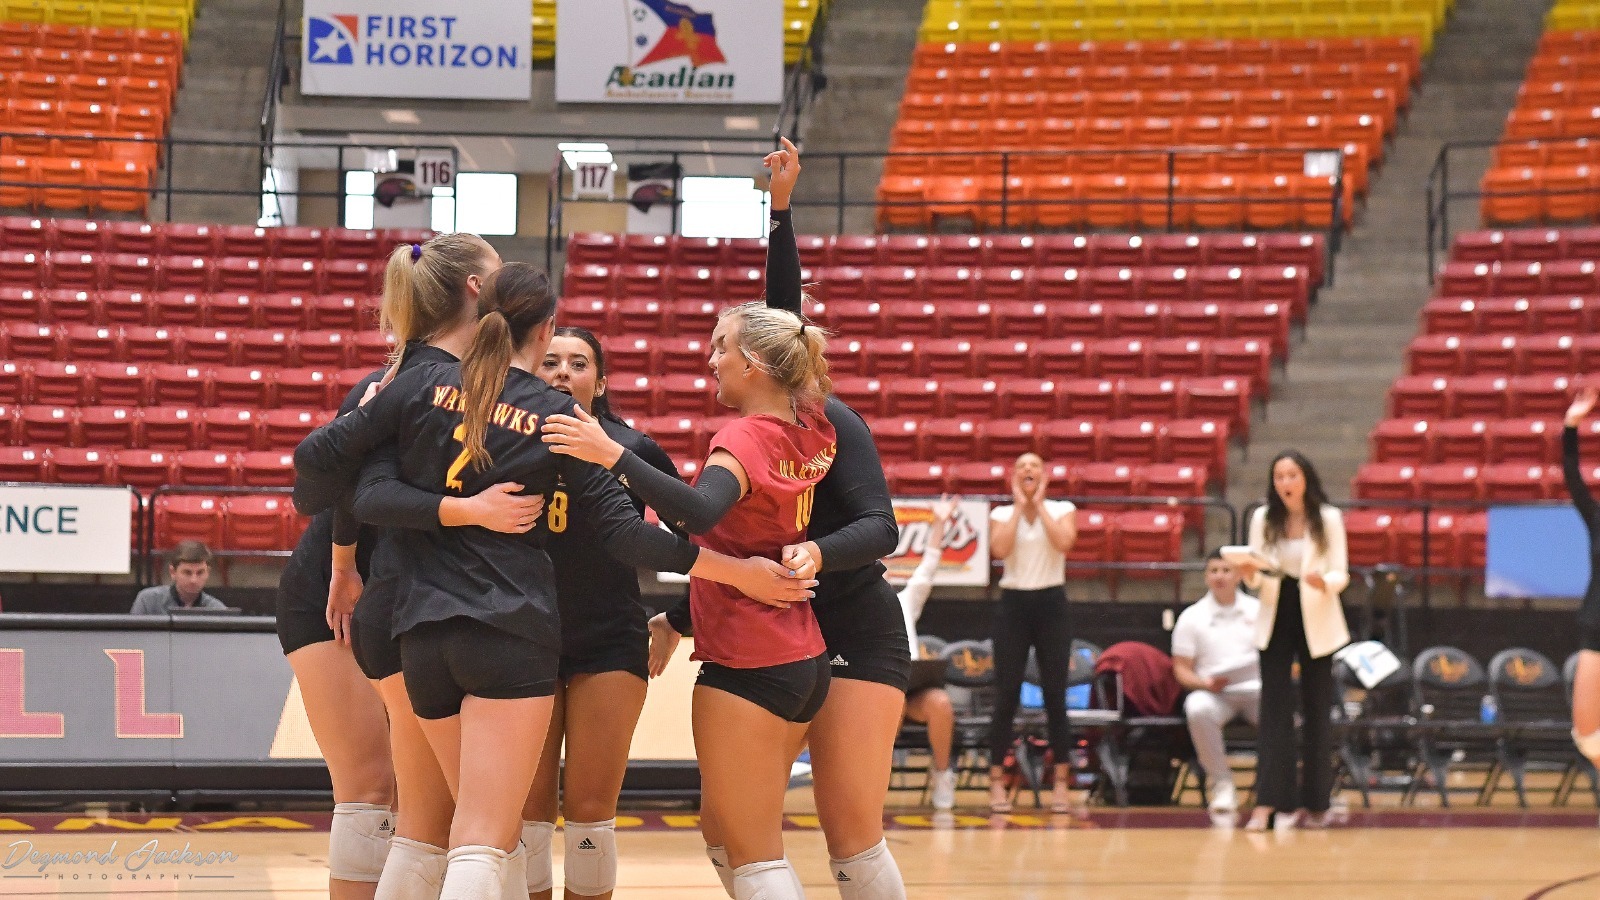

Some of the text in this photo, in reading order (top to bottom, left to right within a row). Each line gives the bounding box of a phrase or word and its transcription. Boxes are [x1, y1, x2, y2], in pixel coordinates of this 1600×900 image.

[366, 16, 457, 39] FIRST
[366, 43, 518, 68] HORIZON
[605, 65, 735, 88] Acadian
[421, 161, 451, 185] 116
[579, 165, 609, 189] 117
[547, 490, 569, 533] 8
